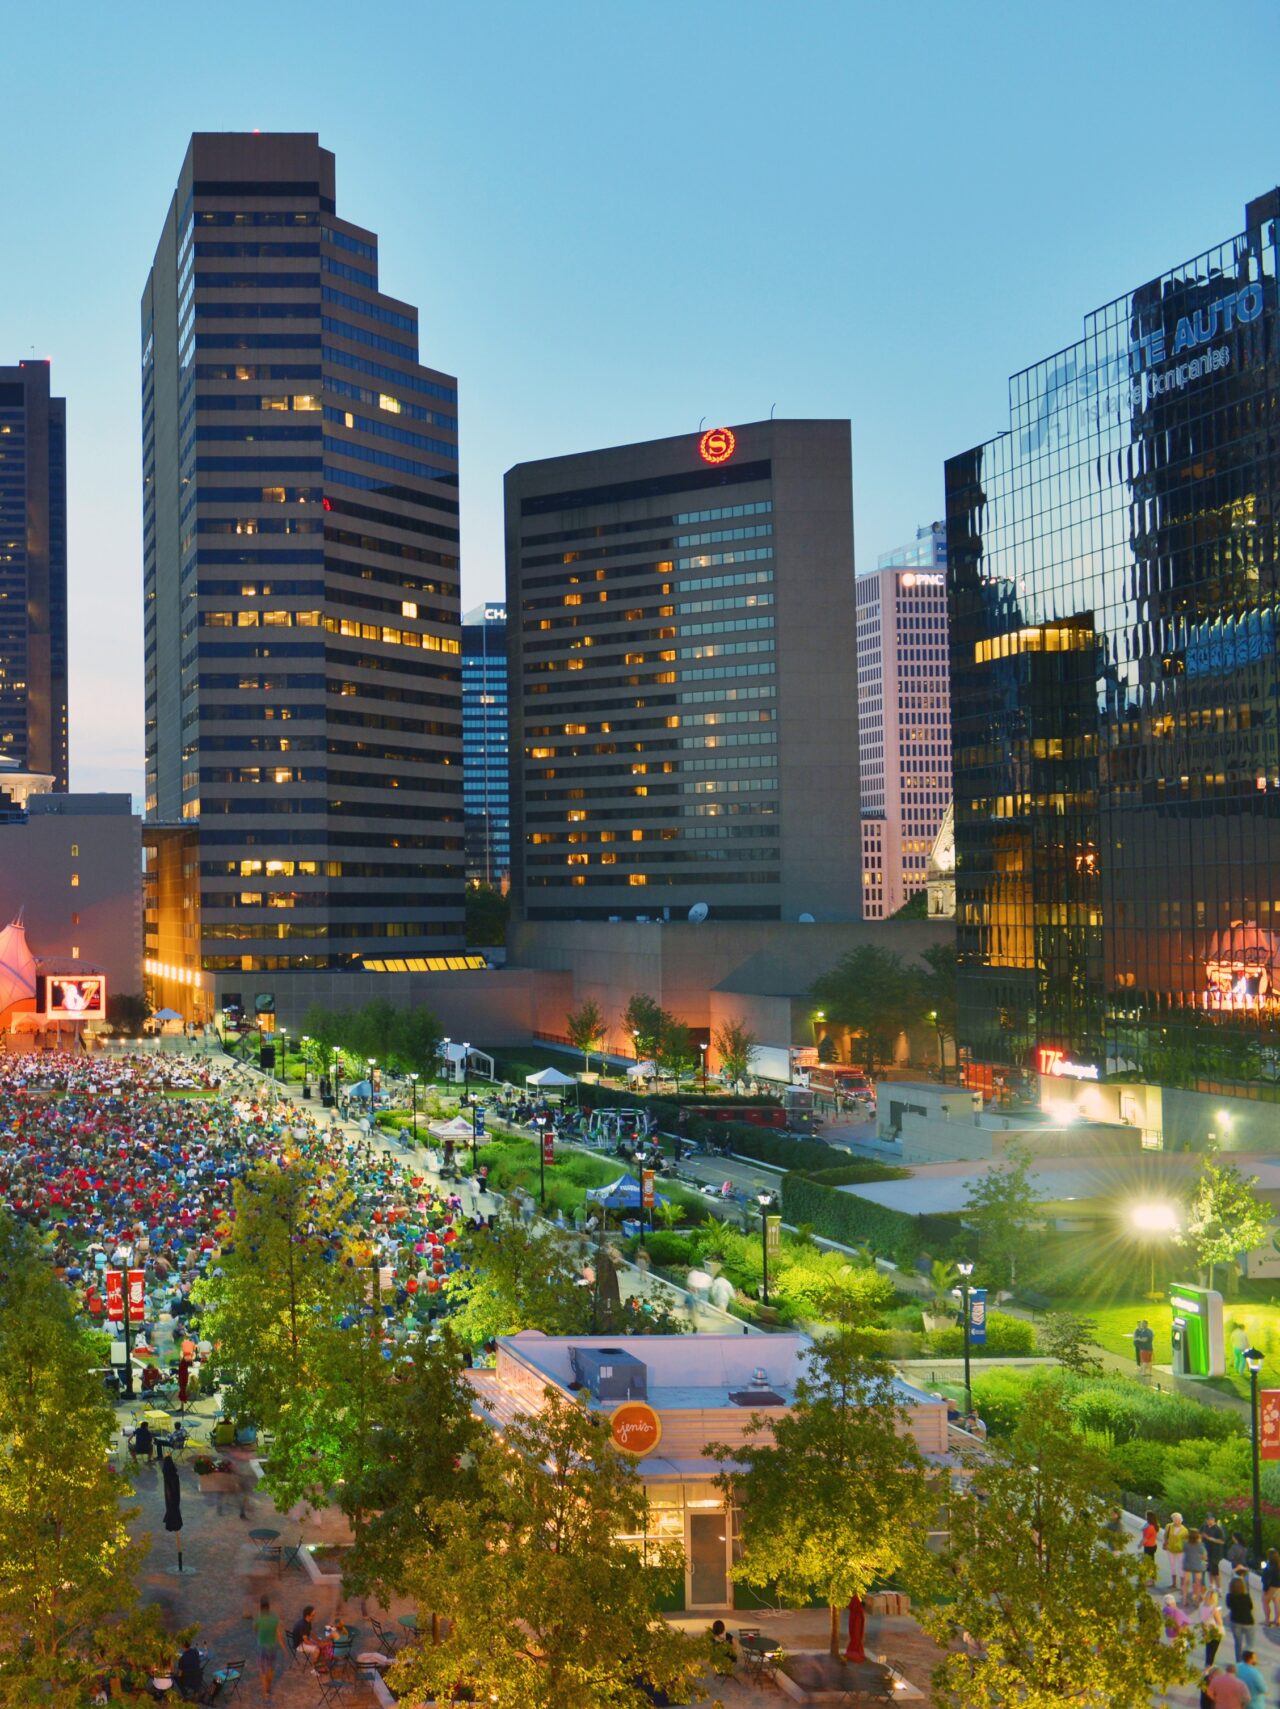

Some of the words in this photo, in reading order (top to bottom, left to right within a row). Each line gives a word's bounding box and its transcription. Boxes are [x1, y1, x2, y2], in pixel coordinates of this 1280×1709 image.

[1079, 327, 1166, 397] STATE
[1171, 282, 1263, 356] AUTO
[1146, 345, 1230, 398] Companies
[915, 574, 944, 586] PNC
[484, 608, 507, 620] CH
